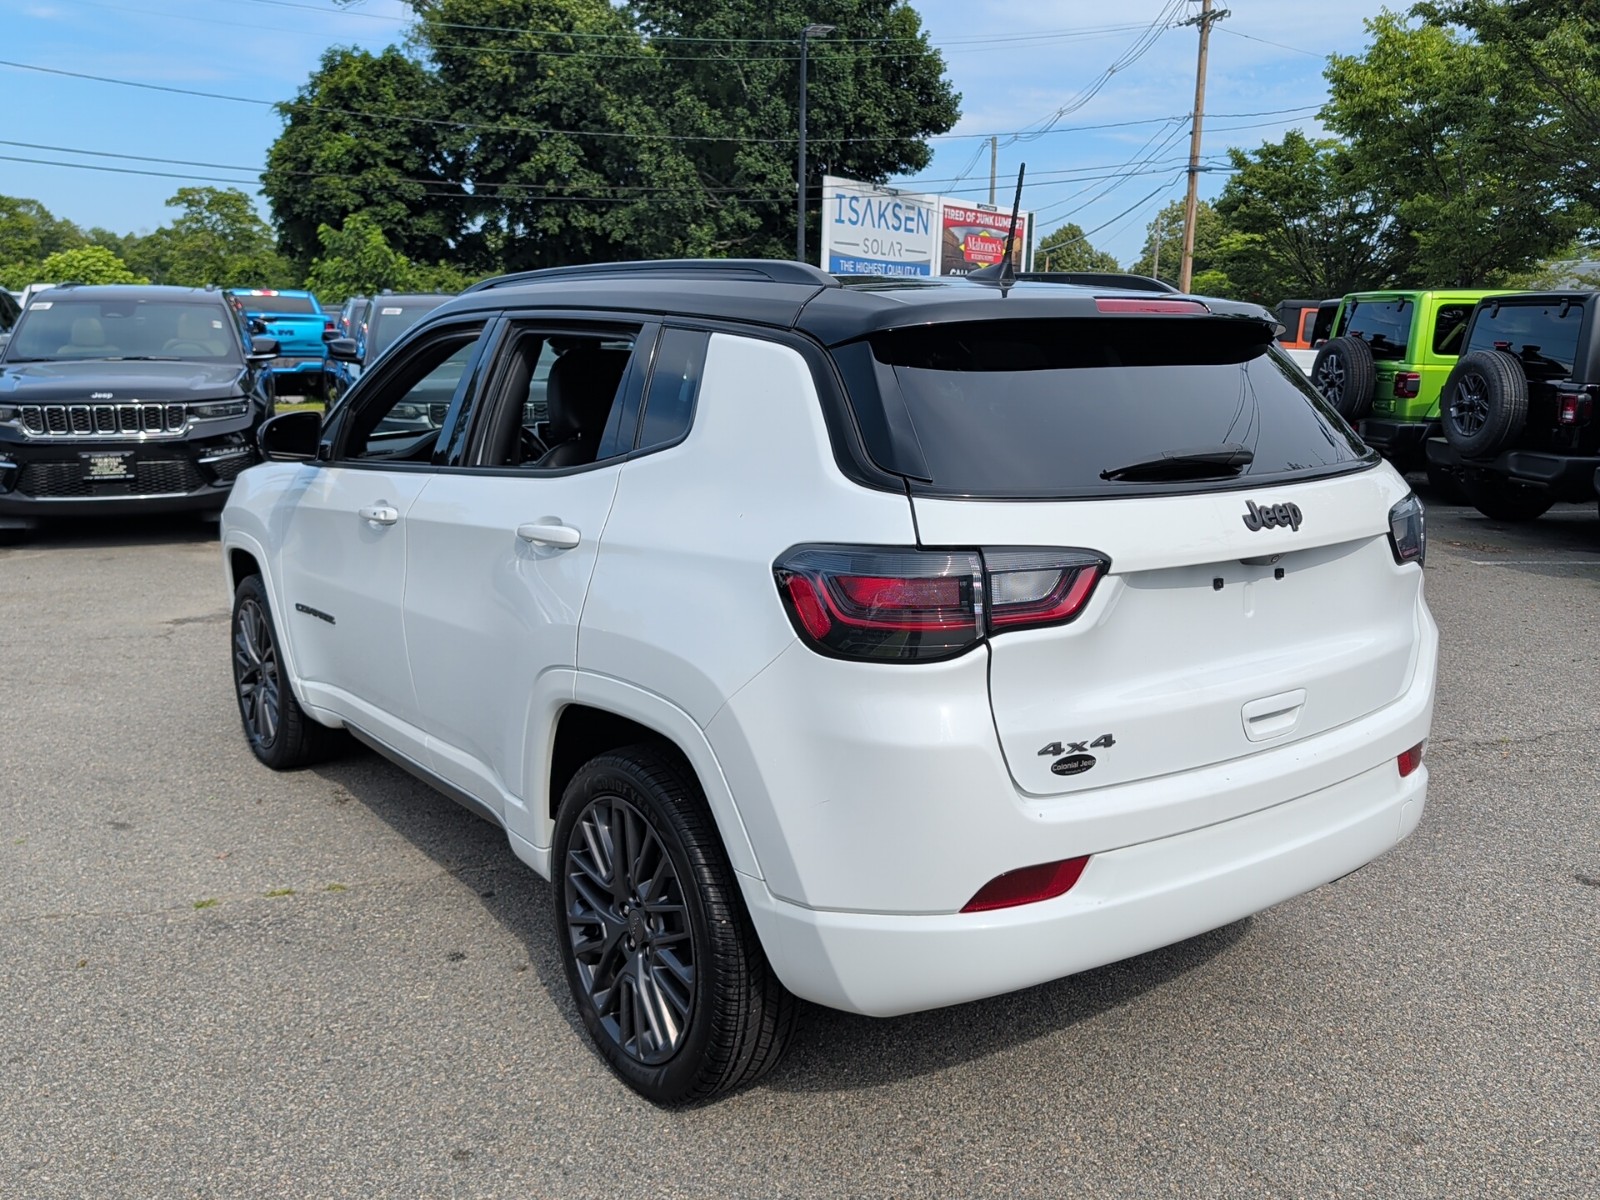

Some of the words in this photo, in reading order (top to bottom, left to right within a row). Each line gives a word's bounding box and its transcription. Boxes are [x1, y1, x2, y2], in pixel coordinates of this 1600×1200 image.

[834, 193, 930, 235] ISAKSEN
[943, 208, 965, 221] TIRED
[965, 211, 976, 223] OF
[976, 213, 994, 225] JUNK
[994, 216, 1024, 230] LUMBR?
[863, 238, 903, 257] SOLAR
[839, 260, 855, 272] THE
[856, 261, 886, 275] HIGHEST
[90, 391, 113, 400] Jeep
[1242, 499, 1303, 532] Jeep
[1052, 761, 1079, 772] Colonial
[1079, 759, 1096, 768] Jeep
